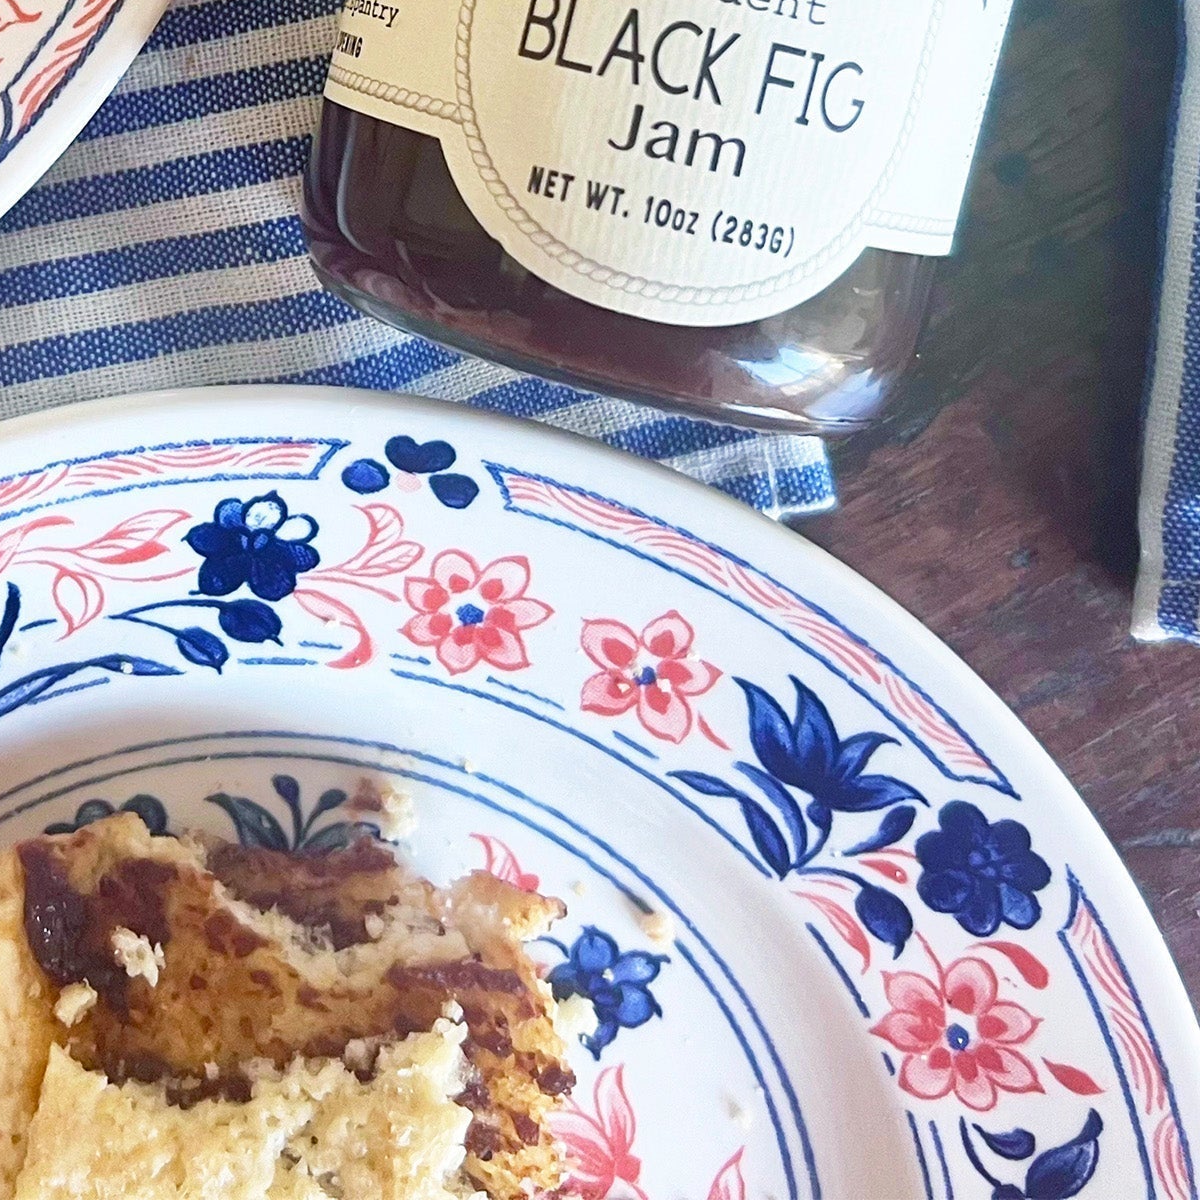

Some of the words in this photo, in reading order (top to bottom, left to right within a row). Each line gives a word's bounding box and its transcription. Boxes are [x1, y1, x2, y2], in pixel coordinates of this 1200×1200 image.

[754, 42, 866, 134] FIG
[607, 104, 747, 178] Jam
[526, 166, 576, 202] NET
[586, 180, 629, 219] WT.
[711, 210, 796, 259] (283G)
